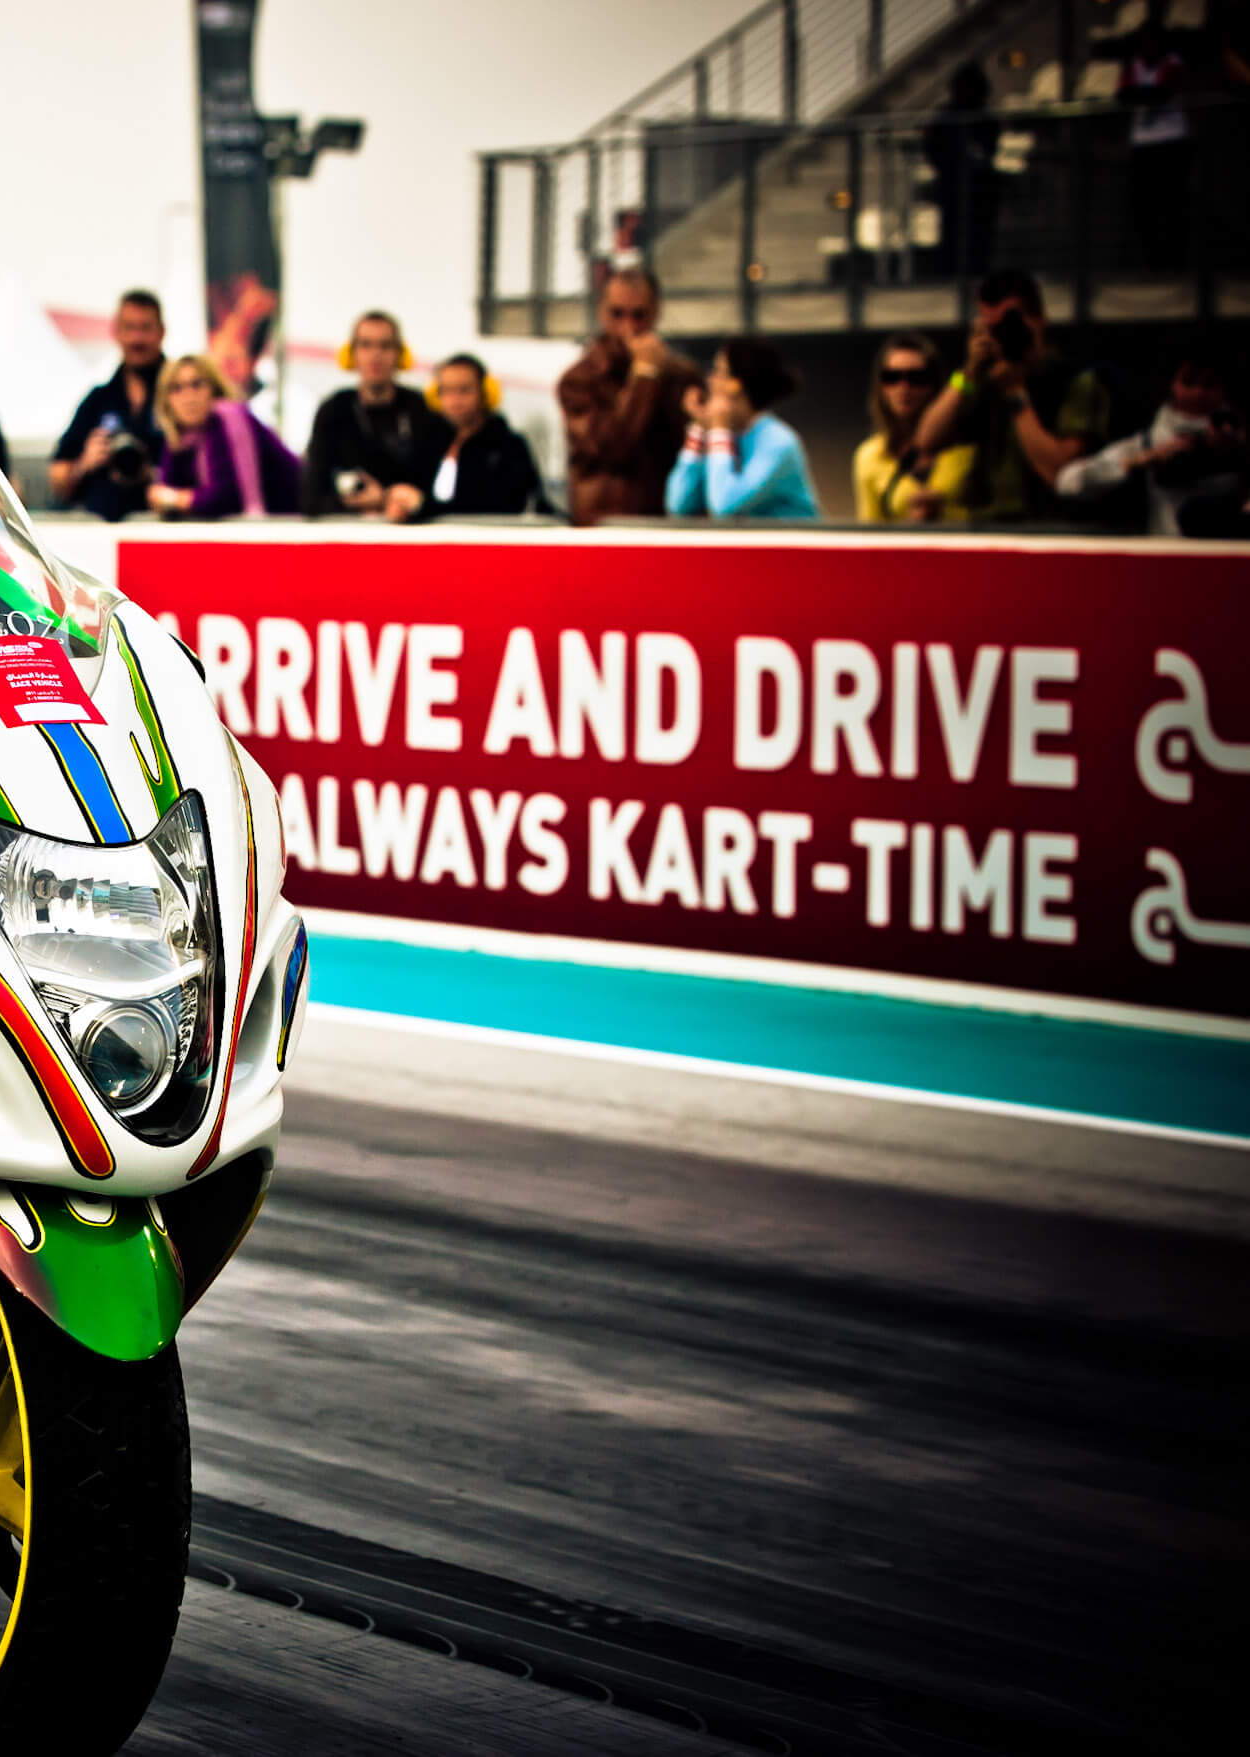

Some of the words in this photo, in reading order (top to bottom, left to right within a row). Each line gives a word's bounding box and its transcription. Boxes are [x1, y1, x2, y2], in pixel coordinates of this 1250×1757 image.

[155, 612, 464, 752] RRIVE
[483, 625, 702, 765] AND
[733, 634, 1080, 789] DRIVE
[280, 771, 569, 896] ALWAYS
[587, 797, 1078, 945] KART-TIME
